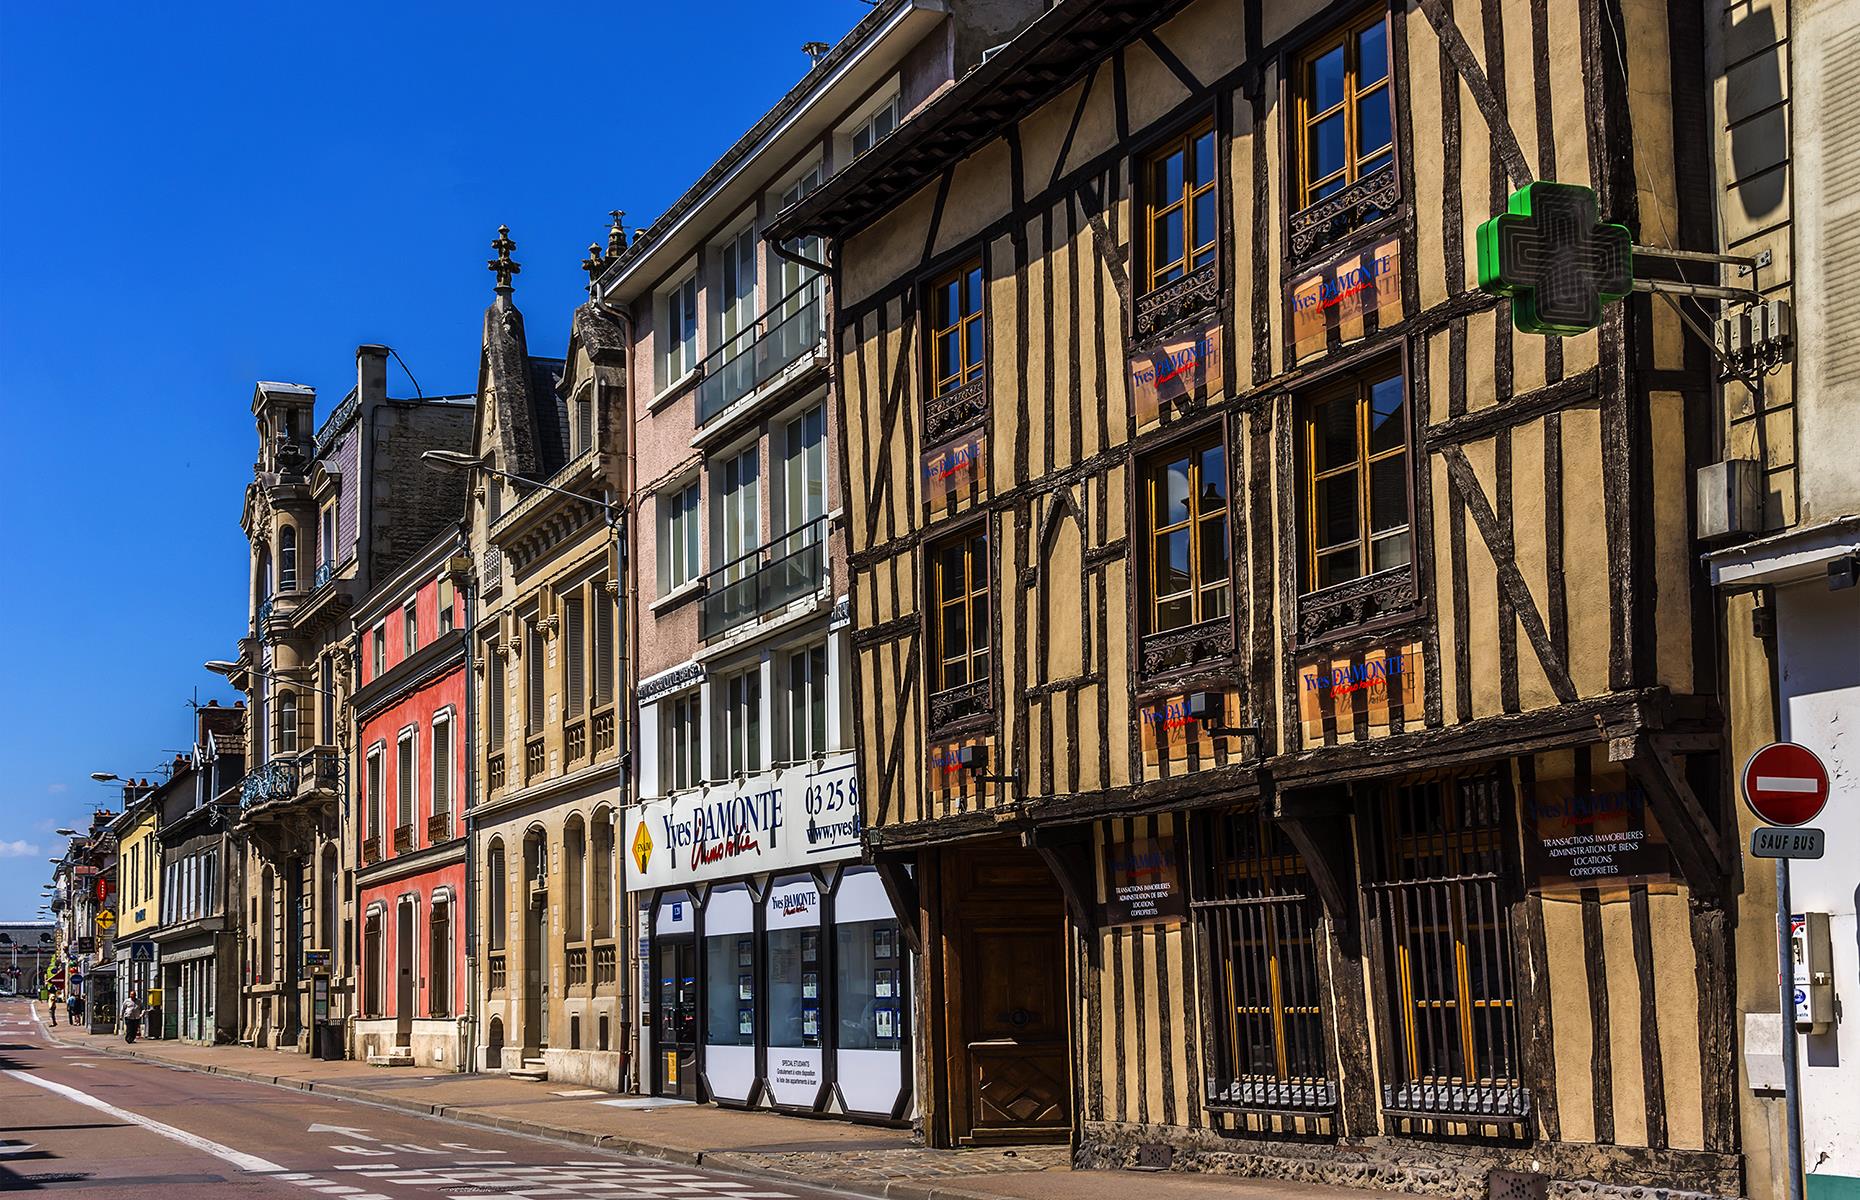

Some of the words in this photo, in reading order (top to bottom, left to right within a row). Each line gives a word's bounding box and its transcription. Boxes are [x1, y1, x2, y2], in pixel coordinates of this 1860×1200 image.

[1291, 292, 1317, 313] Yves
[1319, 255, 1391, 301] DAMONTE
[1133, 369, 1154, 387] Yves
[1155, 337, 1214, 377] DAMONTE
[1304, 674, 1330, 691] Yves
[1331, 655, 1405, 686] DAMONTE
[805, 785, 823, 815] 03
[826, 779, 844, 812] 25
[849, 776, 860, 806] 8
[663, 814, 691, 849] Yves
[693, 788, 783, 843] DAMONTE
[1543, 834, 1595, 848] TRANSACTIONS
[1595, 830, 1644, 843] IMMOBILIERES
[1760, 834, 1789, 850] SAUF
[1793, 836, 1815, 851] BUS
[1549, 844, 1606, 858] ADMINISTRATION
[1608, 843, 1617, 853] DE
[1618, 842, 1639, 852] BIENS
[1573, 855, 1613, 866] LOCATIONS
[1569, 865, 1619, 877] COPROPRIETES
[772, 896, 784, 909] Yves
[784, 891, 817, 908] DAMONTE
[328, 1142, 508, 1156] BUS
